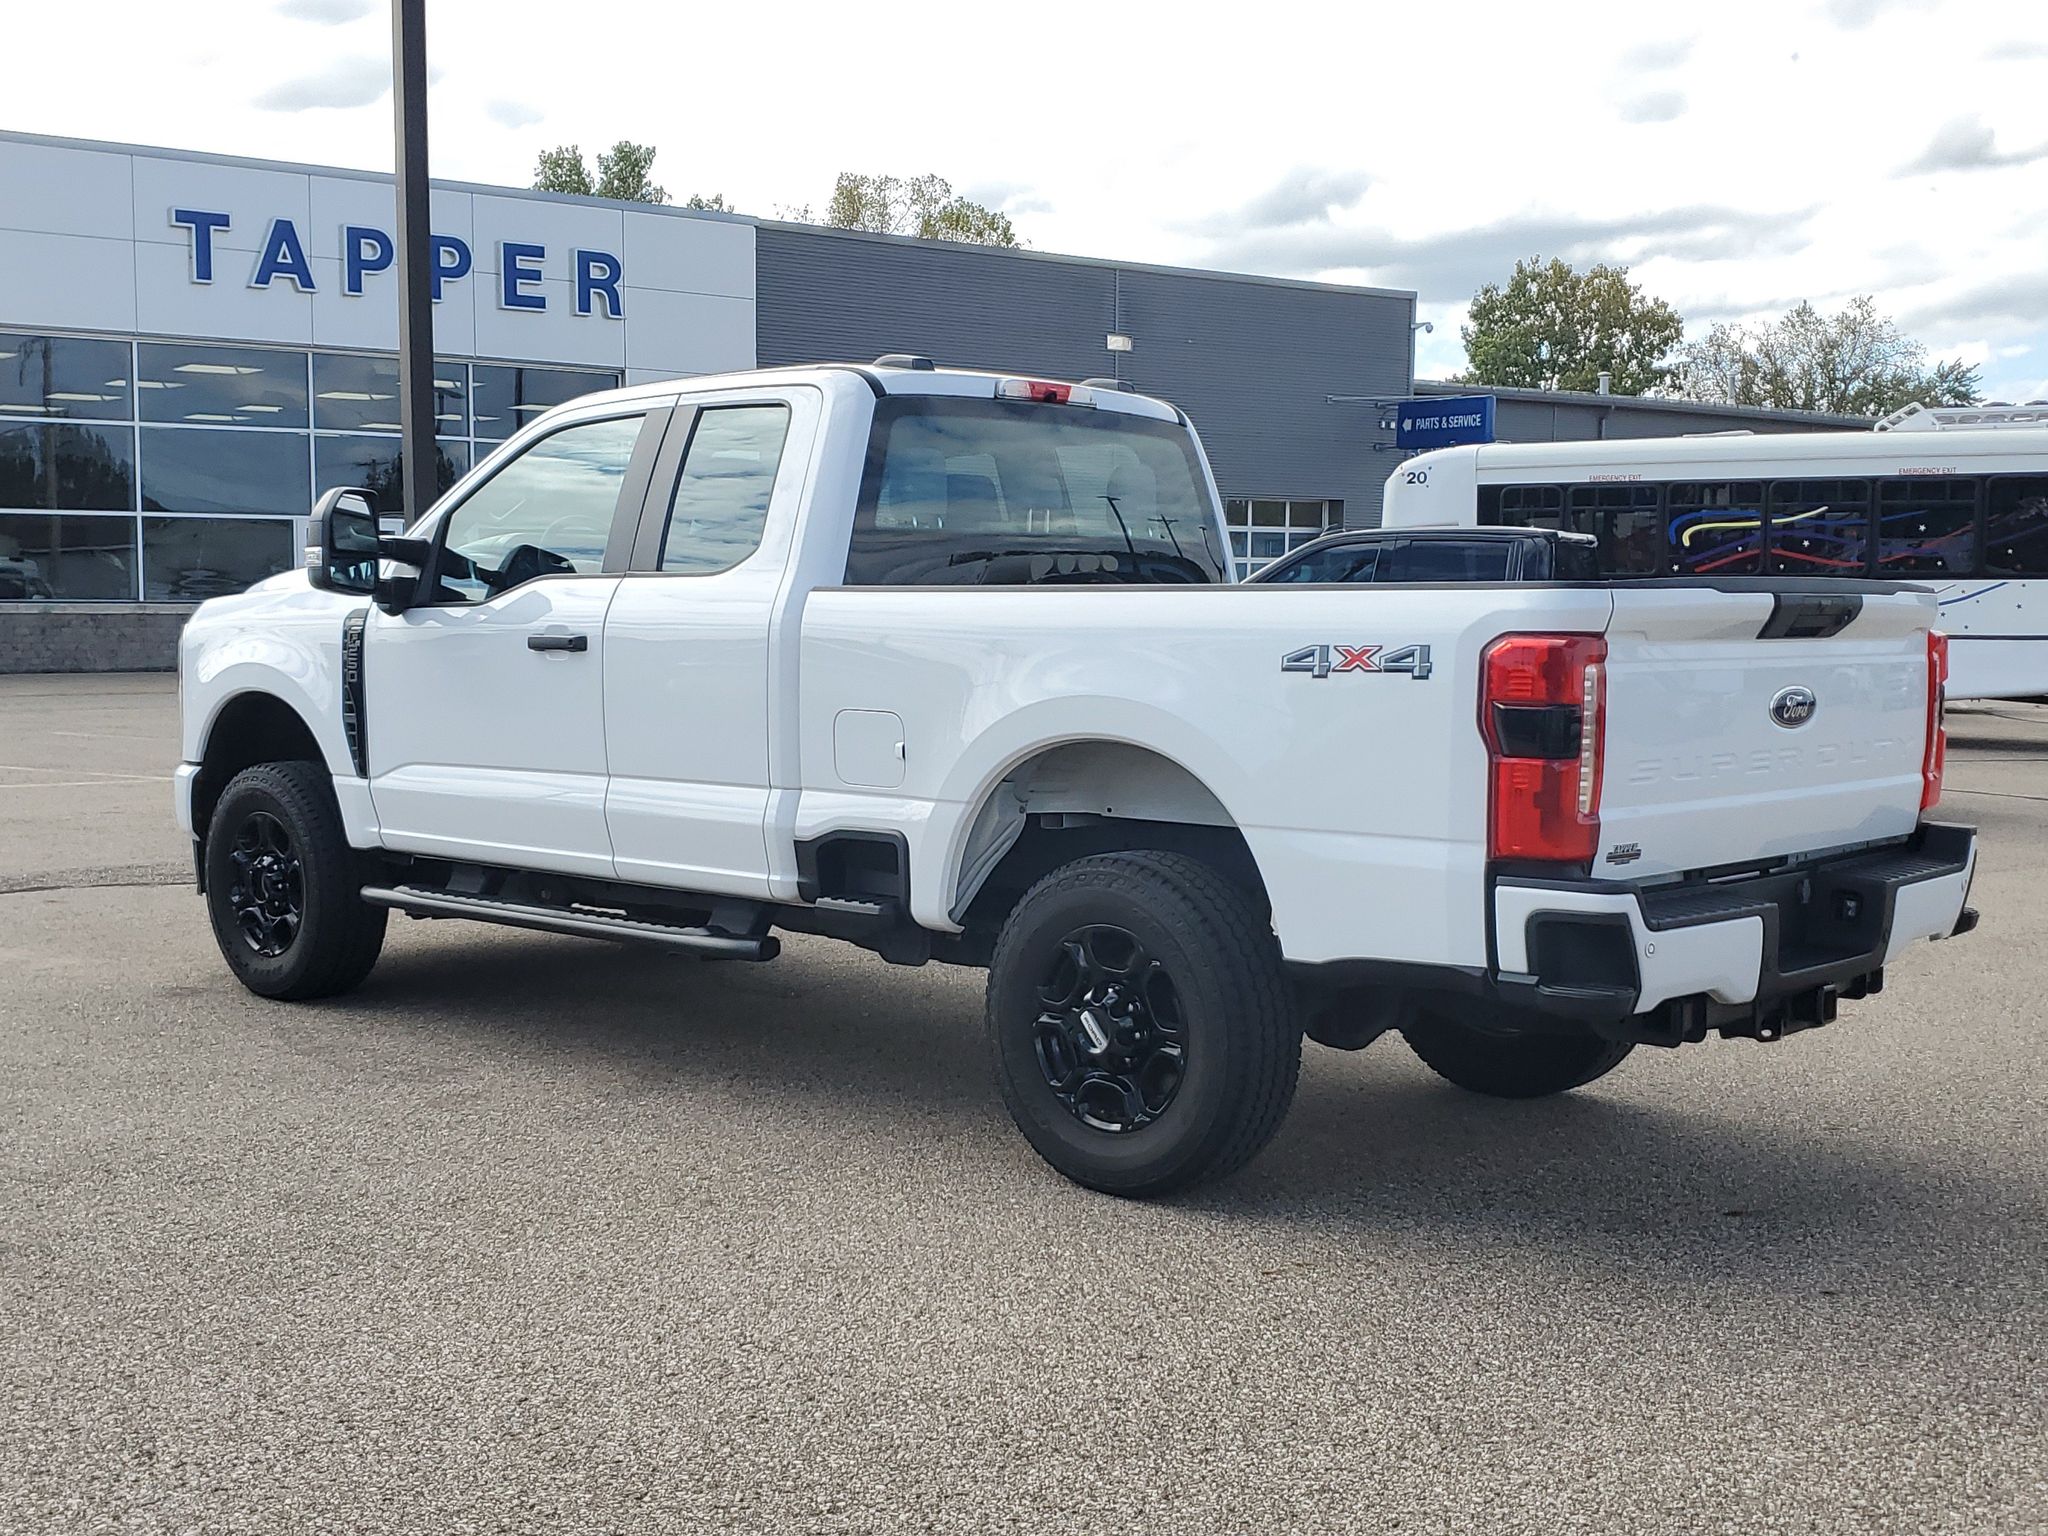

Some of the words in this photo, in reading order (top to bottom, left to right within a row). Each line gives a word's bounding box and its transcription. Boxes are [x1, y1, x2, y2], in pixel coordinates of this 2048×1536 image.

[168, 206, 626, 320] TAPPER
[1416, 417, 1439, 430] PARTS
[1441, 416, 1447, 428] &
[1448, 414, 1481, 428] SERVICE
[1406, 471, 1428, 485] 20
[1589, 474, 1628, 482] EMERGENCY
[1629, 473, 1642, 481] EXIT
[1899, 467, 1941, 475] EMERGENCY
[1942, 466, 1957, 474] EXIT
[1628, 747, 1804, 785] SUPER
[1083, 1017, 1103, 1046] FORD
